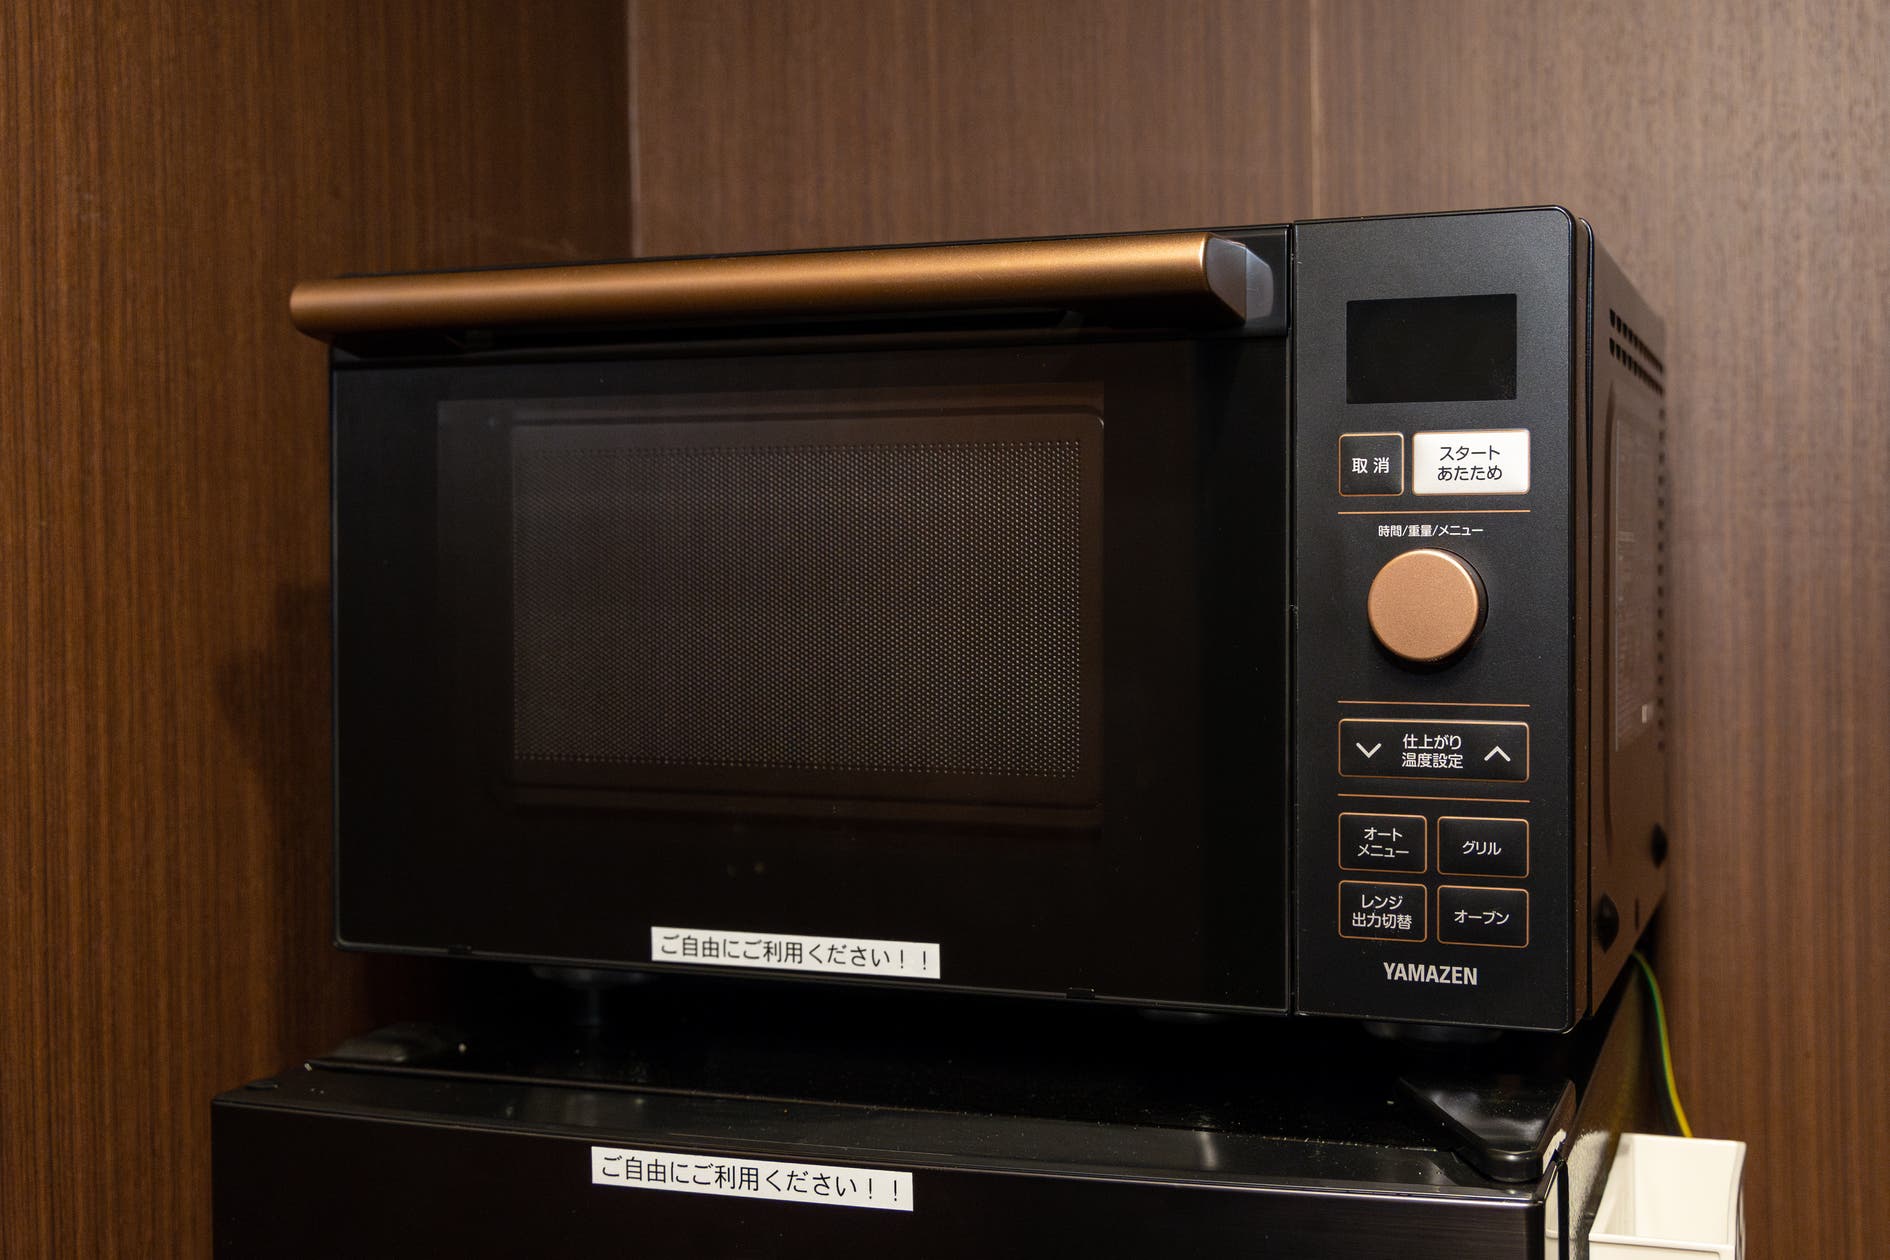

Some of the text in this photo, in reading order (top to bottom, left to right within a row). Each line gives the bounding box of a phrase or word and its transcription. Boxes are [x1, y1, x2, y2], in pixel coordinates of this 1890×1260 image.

[1439, 445, 1501, 461] スタート
[1437, 464, 1503, 482] あたため
[1378, 524, 1484, 538] 時間/重量/メニュー
[1402, 733, 1462, 750] 仕上がり
[1401, 751, 1464, 769] 温度設定
[1363, 827, 1403, 842] オート
[1357, 843, 1409, 858] メニュー
[1462, 840, 1502, 856] グリル
[1361, 894, 1403, 910] レンジ
[1352, 912, 1413, 930] 出力切替
[1454, 909, 1510, 925] オーブン
[660, 934, 929, 970] ご自由にご利用ください！！
[1383, 962, 1478, 986] YAMAZEN
[601, 1155, 899, 1202] ご自由にご利用ください！！
